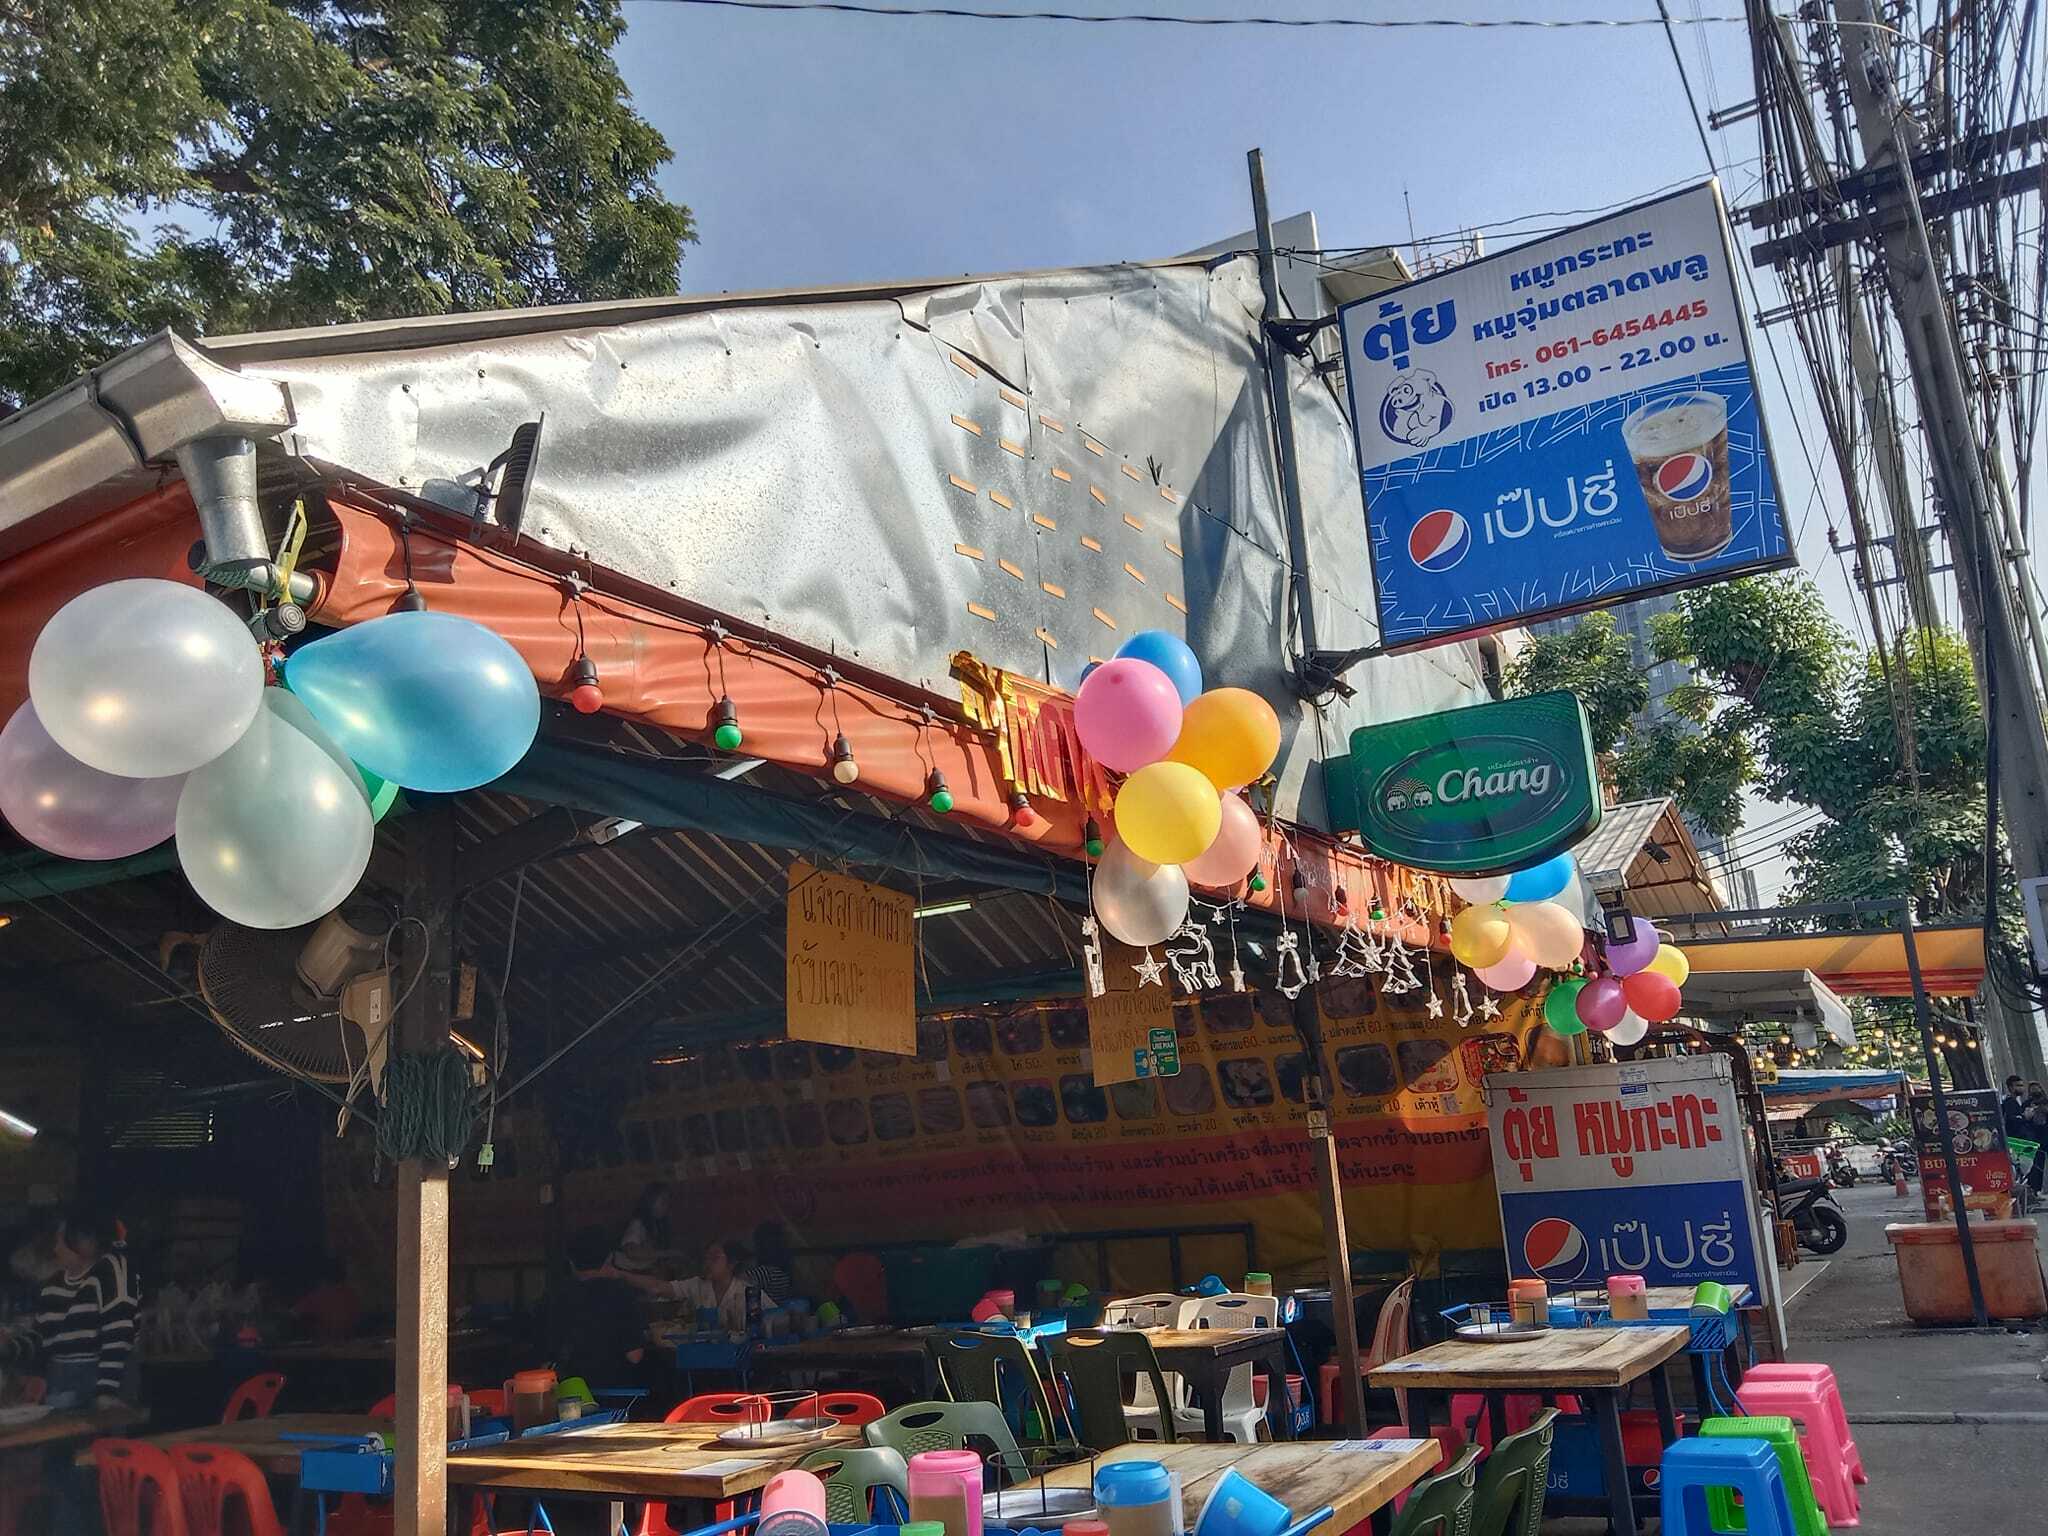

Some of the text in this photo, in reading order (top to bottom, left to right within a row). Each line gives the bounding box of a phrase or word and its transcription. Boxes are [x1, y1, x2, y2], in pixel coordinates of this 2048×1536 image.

[1472, 254, 1709, 342] หมูจุ่มตลาดพลู
[1510, 231, 1654, 292] หมูกระทะ
[1363, 299, 1457, 371] ตุ้ย
[1485, 300, 1709, 380] โทร. 061-6454445
[1478, 390, 1517, 413] เปิด
[1522, 365, 1592, 399] 13.00
[1619, 335, 1697, 372] 22.00
[1482, 459, 1619, 545] เป๊ปซี่
[1437, 764, 1551, 802] Chang
[1502, 1086, 1723, 1183] ตุ้ย หมูกะทะ
[1924, 1156, 1979, 1170] BUET
[1599, 1210, 1736, 1272] เป๊ปซี่
